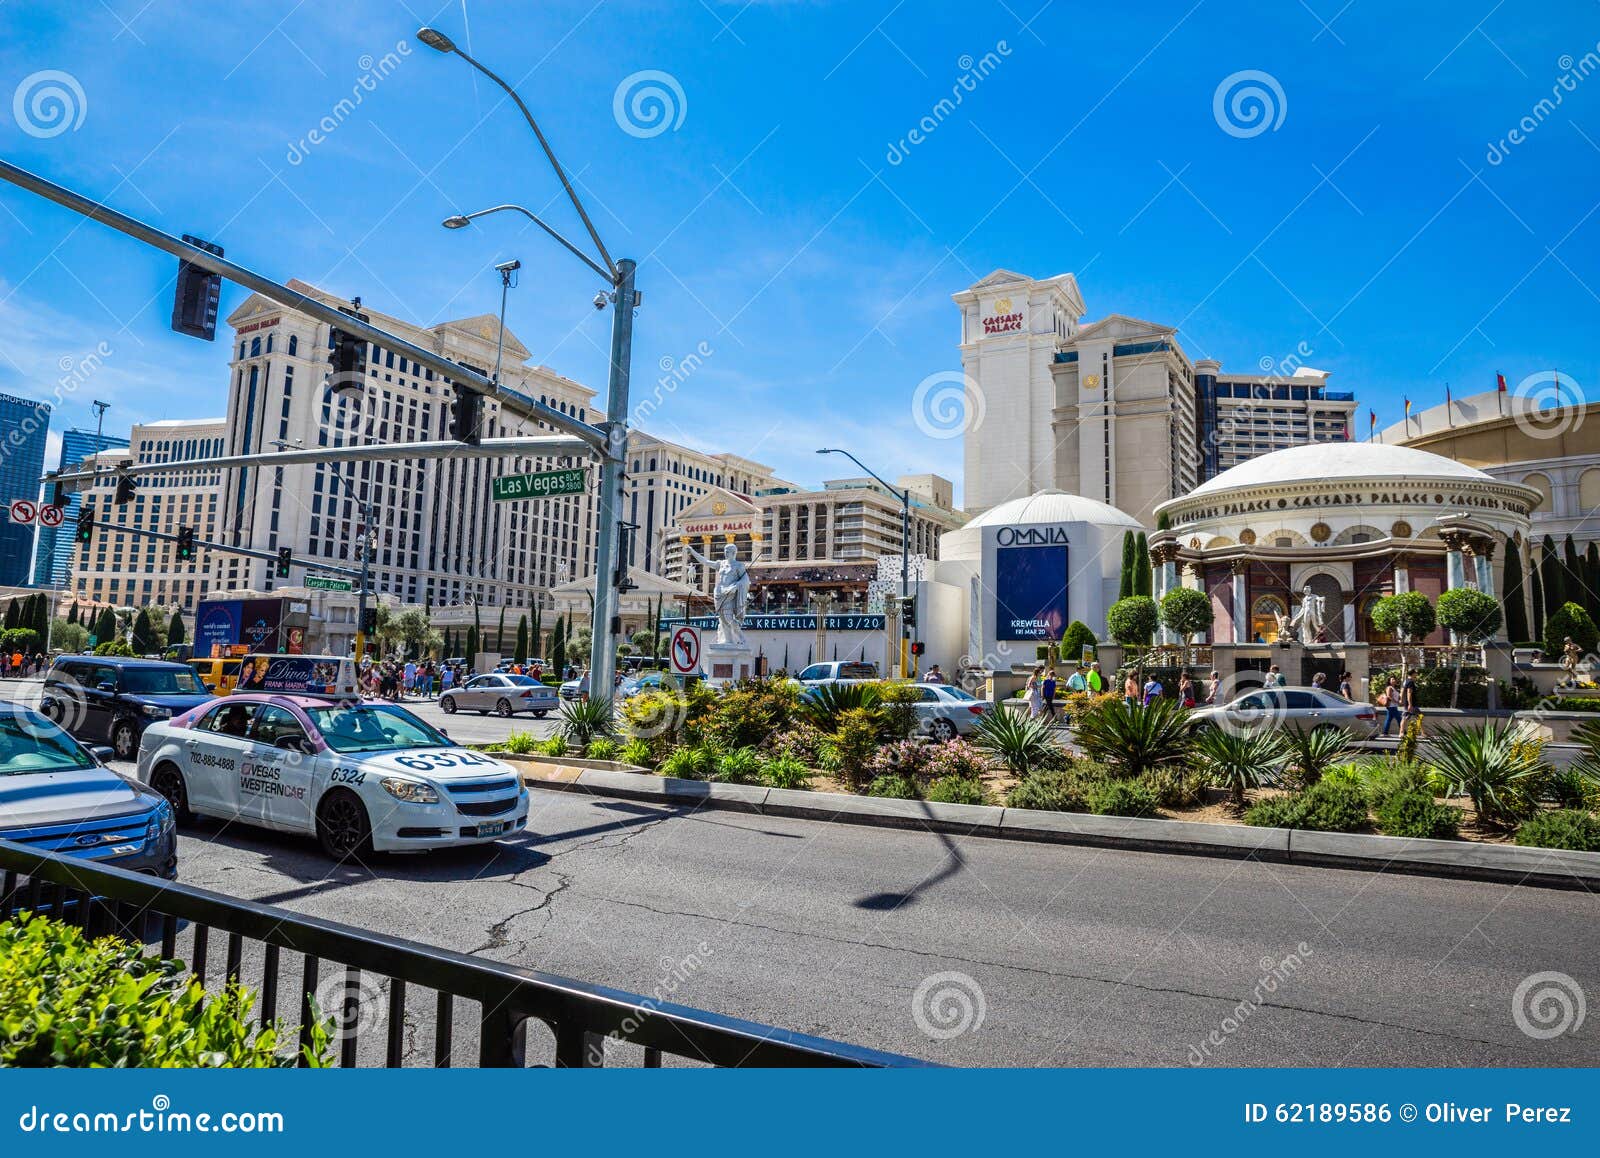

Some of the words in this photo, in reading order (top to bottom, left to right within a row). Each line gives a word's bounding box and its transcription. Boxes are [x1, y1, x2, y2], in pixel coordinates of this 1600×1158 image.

[983, 312, 1023, 325] CAESARS
[985, 322, 1022, 334] PALACE
[500, 479, 522, 494] Las
[524, 474, 566, 495] Vegas
[1182, 507, 1219, 524] CAESARS
[1224, 501, 1271, 515] PALACE
[1294, 493, 1362, 506] CAESARS
[1371, 493, 1428, 504] PALACE
[1451, 495, 1499, 509] CAESARS
[685, 525, 719, 533] CAESARS
[723, 521, 752, 531] PALACE
[996, 526, 1069, 546] OMNIA
[756, 619, 816, 629] KREWELLA
[847, 617, 879, 629] 3/20
[268, 659, 310, 681] Divas
[264, 680, 284, 688] FRANK
[190, 752, 234, 771] 702-888-4888
[395, 753, 498, 771] 6324
[251, 764, 280, 780] VEGAS
[331, 767, 367, 786] 6324
